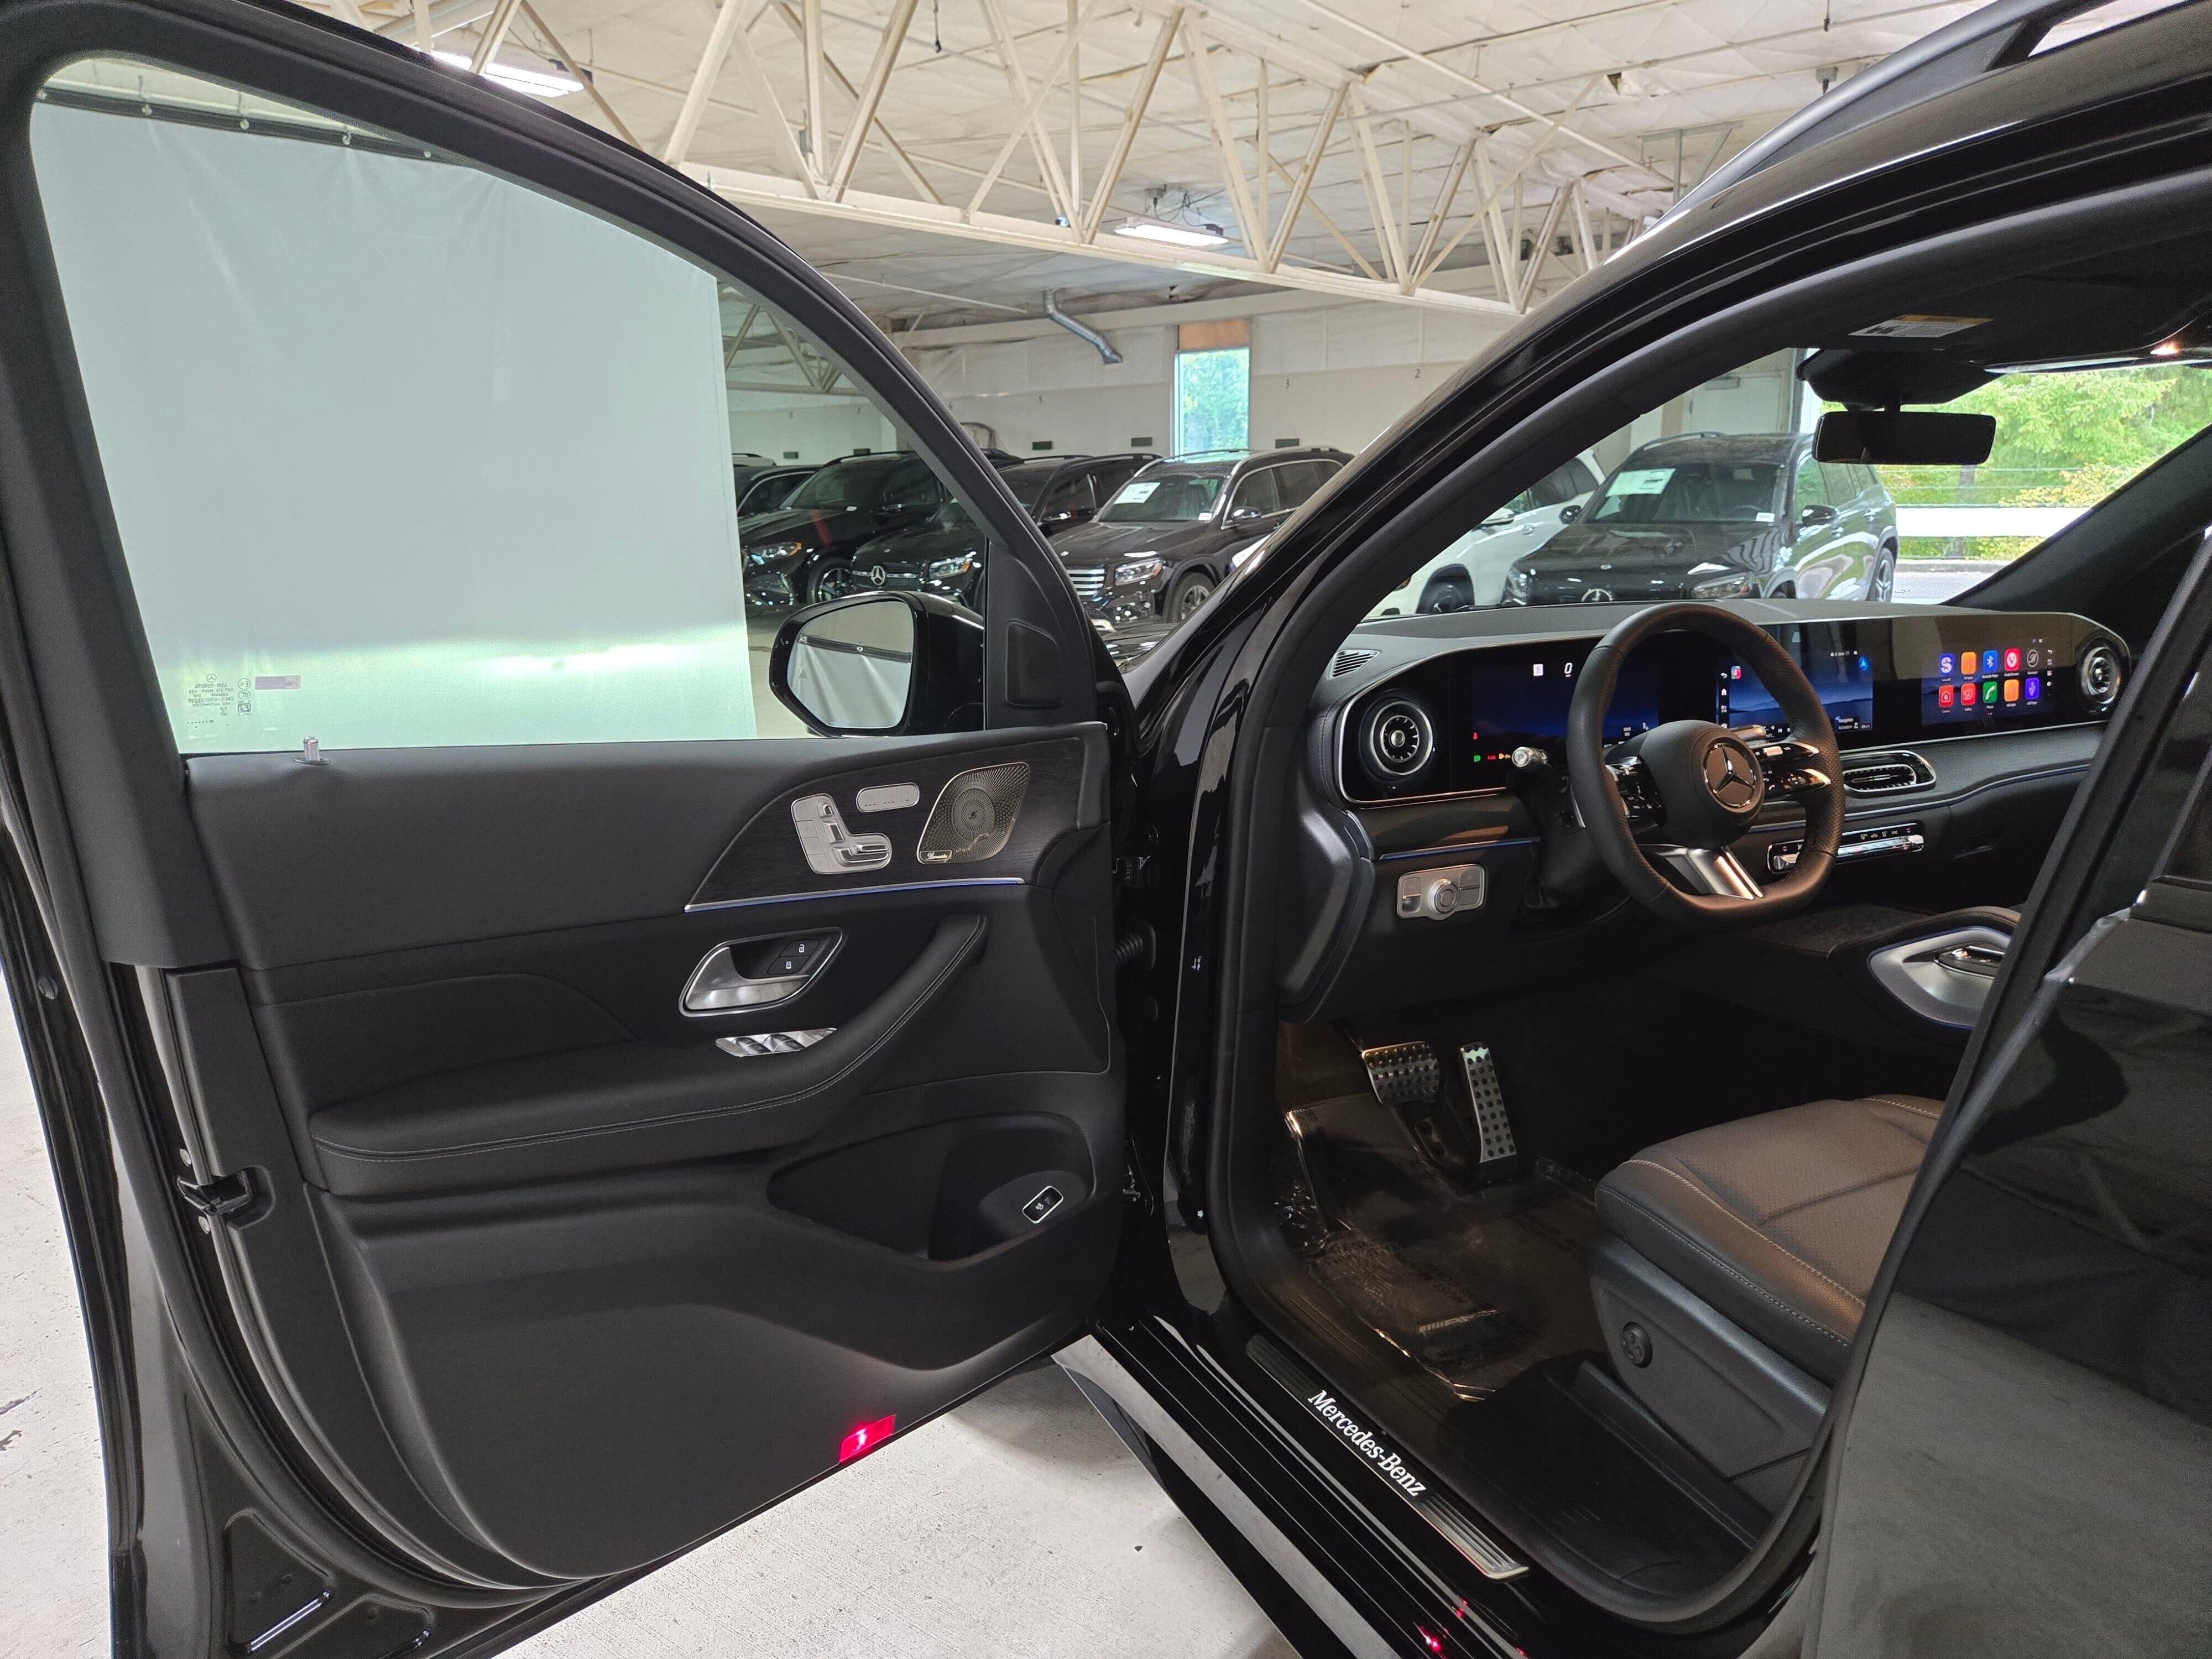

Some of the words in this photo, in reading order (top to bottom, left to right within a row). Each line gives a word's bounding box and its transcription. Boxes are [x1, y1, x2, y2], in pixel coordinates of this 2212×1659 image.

[1415, 368, 1421, 379] 2
[1285, 378, 1290, 389] 3
[1564, 662, 1573, 674] 0
[1308, 1390, 1426, 1496] Mercedes-Benz
